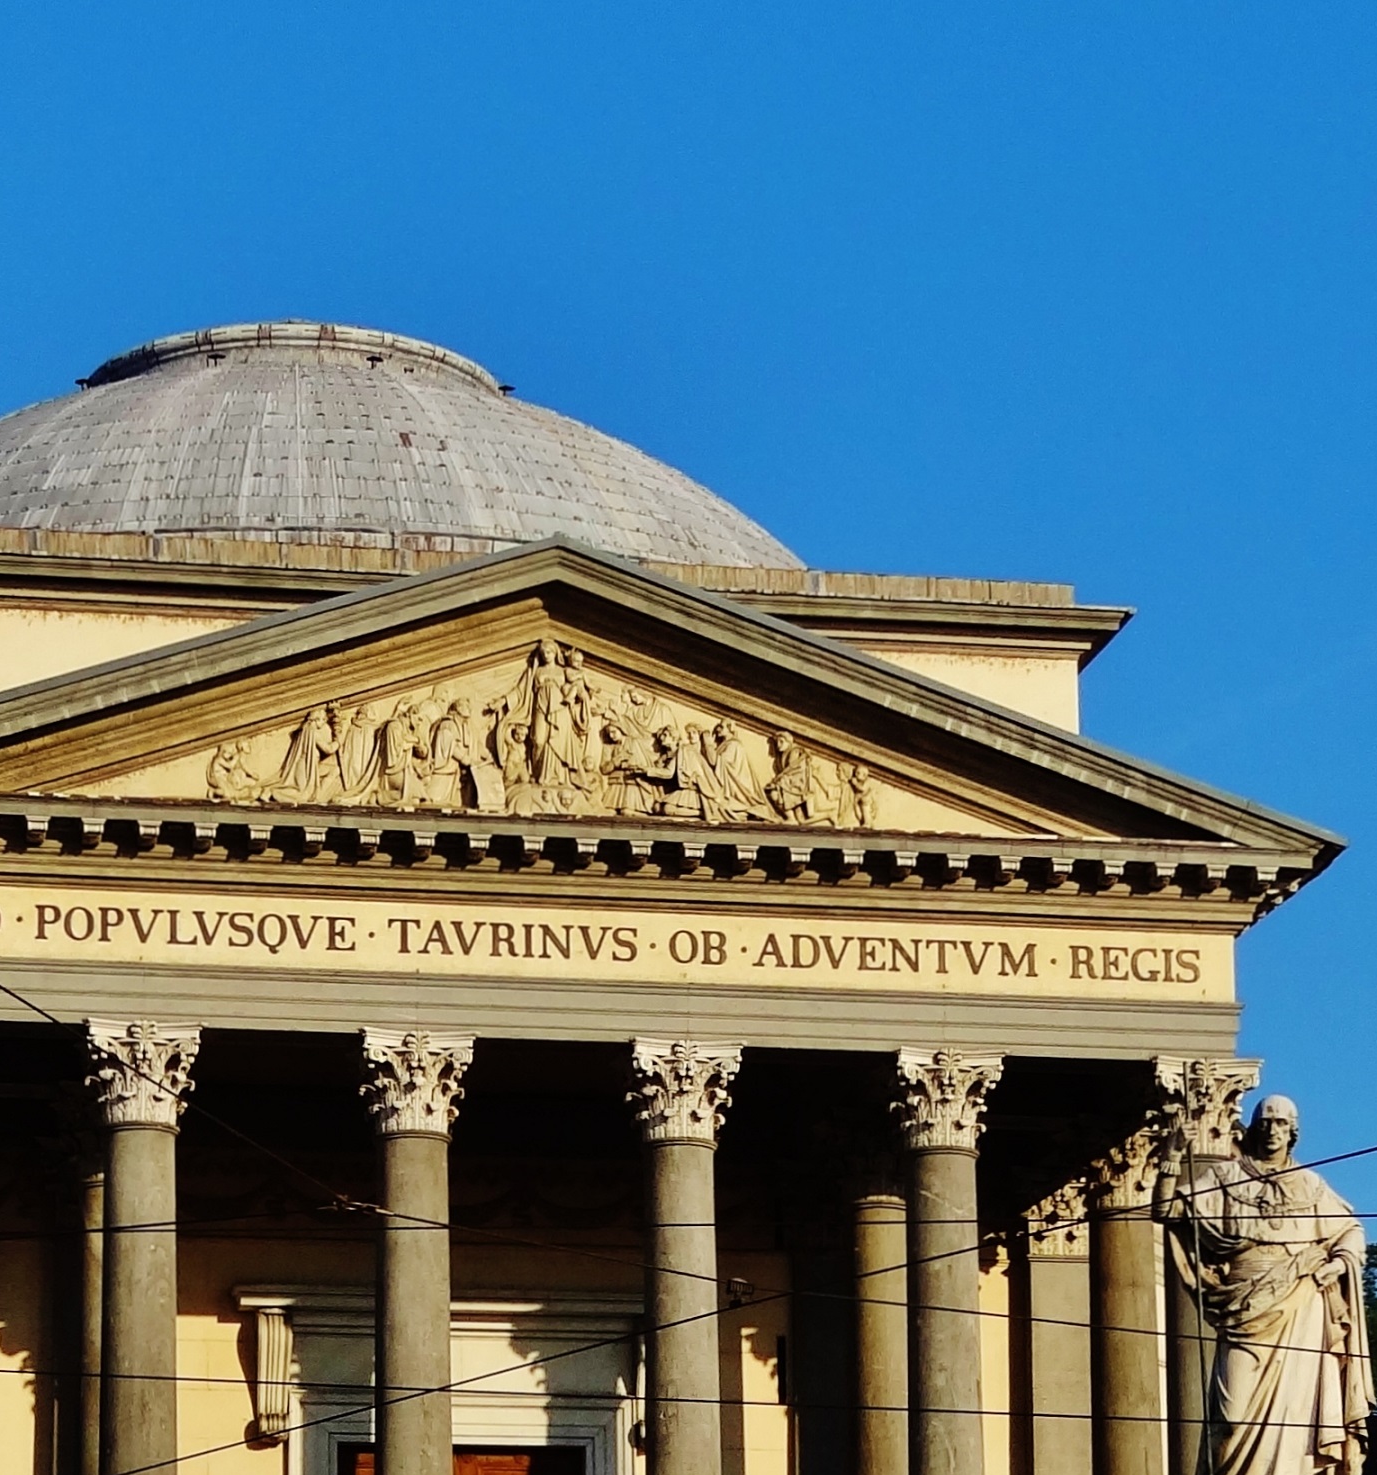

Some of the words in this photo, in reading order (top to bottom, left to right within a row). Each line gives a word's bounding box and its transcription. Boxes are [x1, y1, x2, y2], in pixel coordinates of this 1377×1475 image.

[34, 903, 357, 955] POPVLVSQVE
[387, 917, 639, 962] TAVRINVS
[668, 928, 729, 966] OB
[751, 932, 1039, 978] ADVENTVM
[1068, 944, 1202, 984] REGIS
